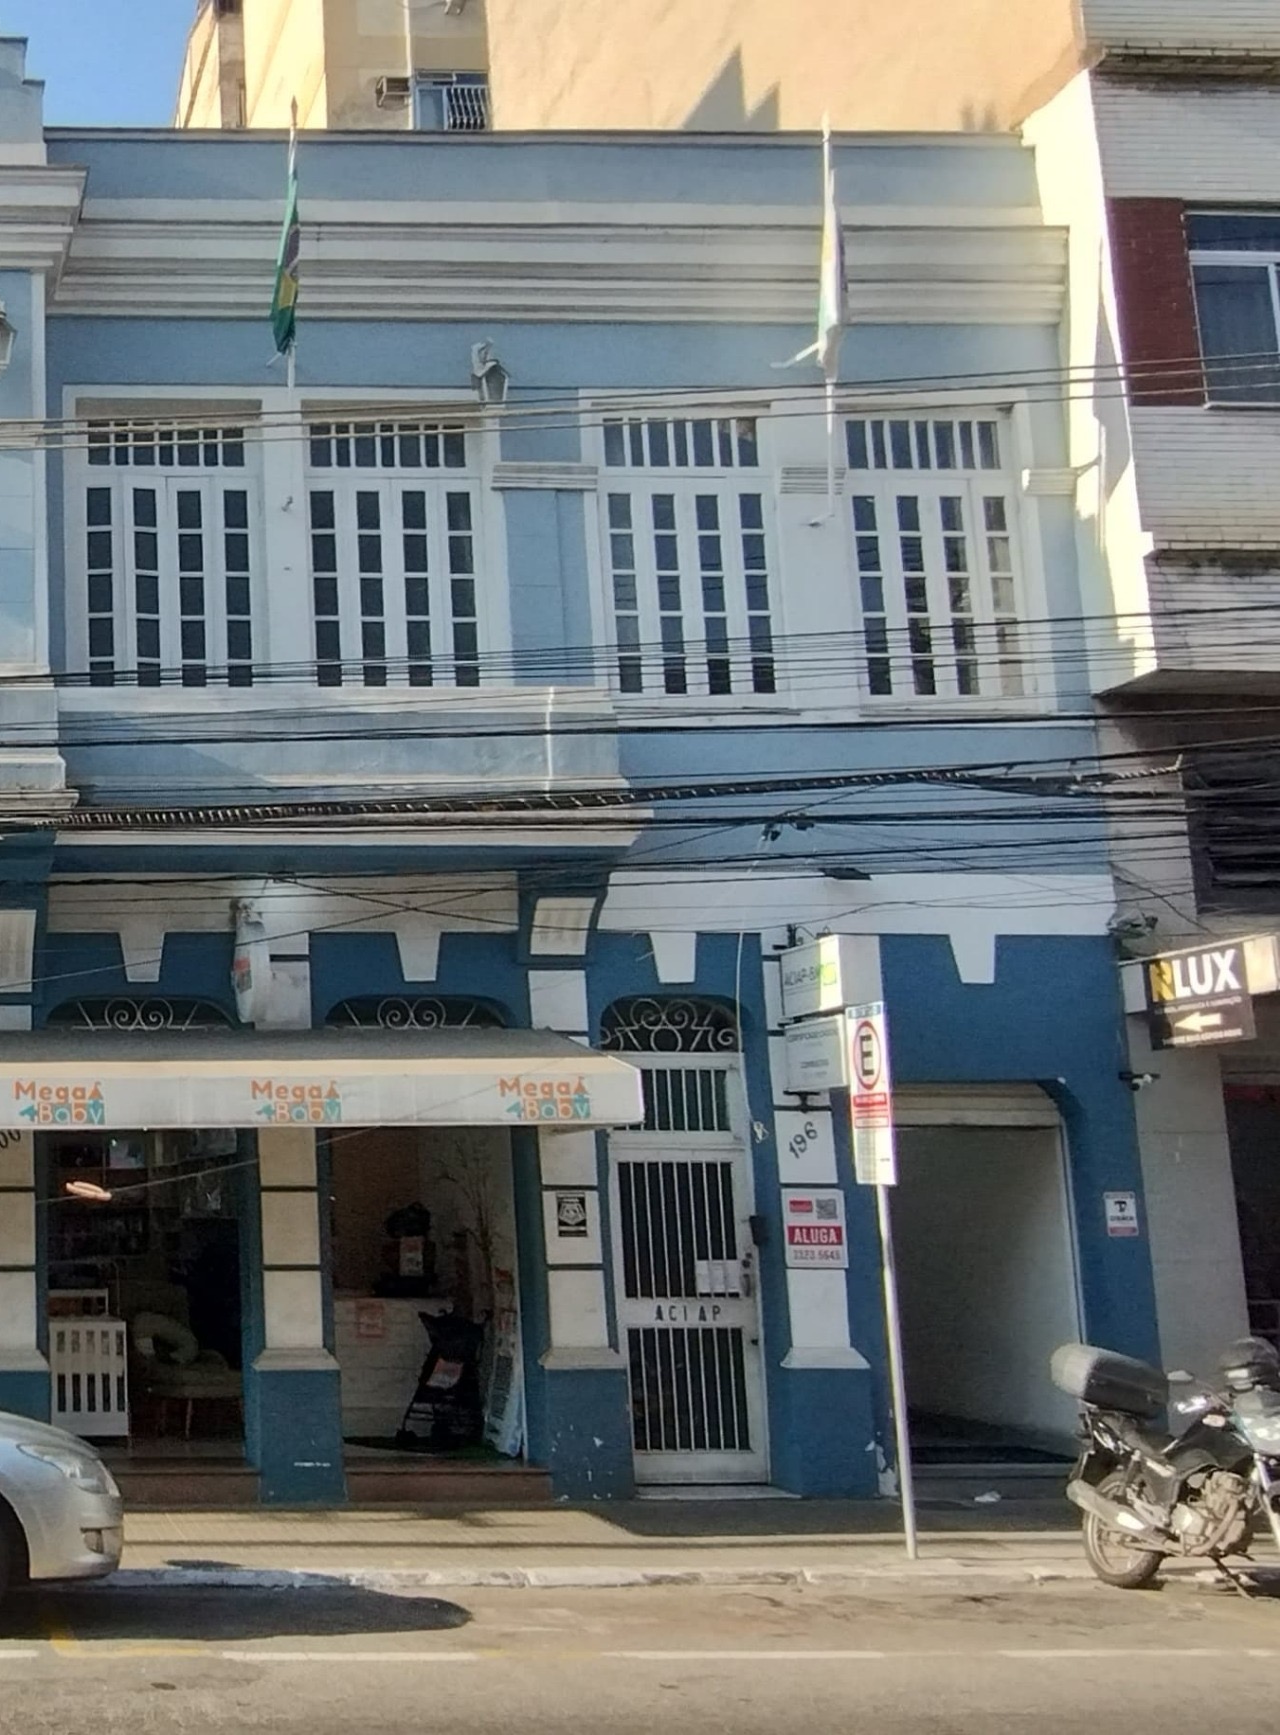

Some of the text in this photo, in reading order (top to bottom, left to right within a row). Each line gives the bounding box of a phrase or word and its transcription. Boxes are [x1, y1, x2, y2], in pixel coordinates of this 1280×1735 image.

[859, 1033, 875, 1077] E
[14, 1081, 86, 1104] Mega
[251, 1080, 322, 1104] Mega
[499, 1077, 570, 1099] Mega
[37, 1103, 105, 1125] Baby
[275, 1101, 341, 1123] Baby
[524, 1098, 590, 1120] Baby
[789, 1121, 818, 1159] 196
[793, 1227, 838, 1244] ALUGA
[655, 1304, 722, 1322] ACIAP
